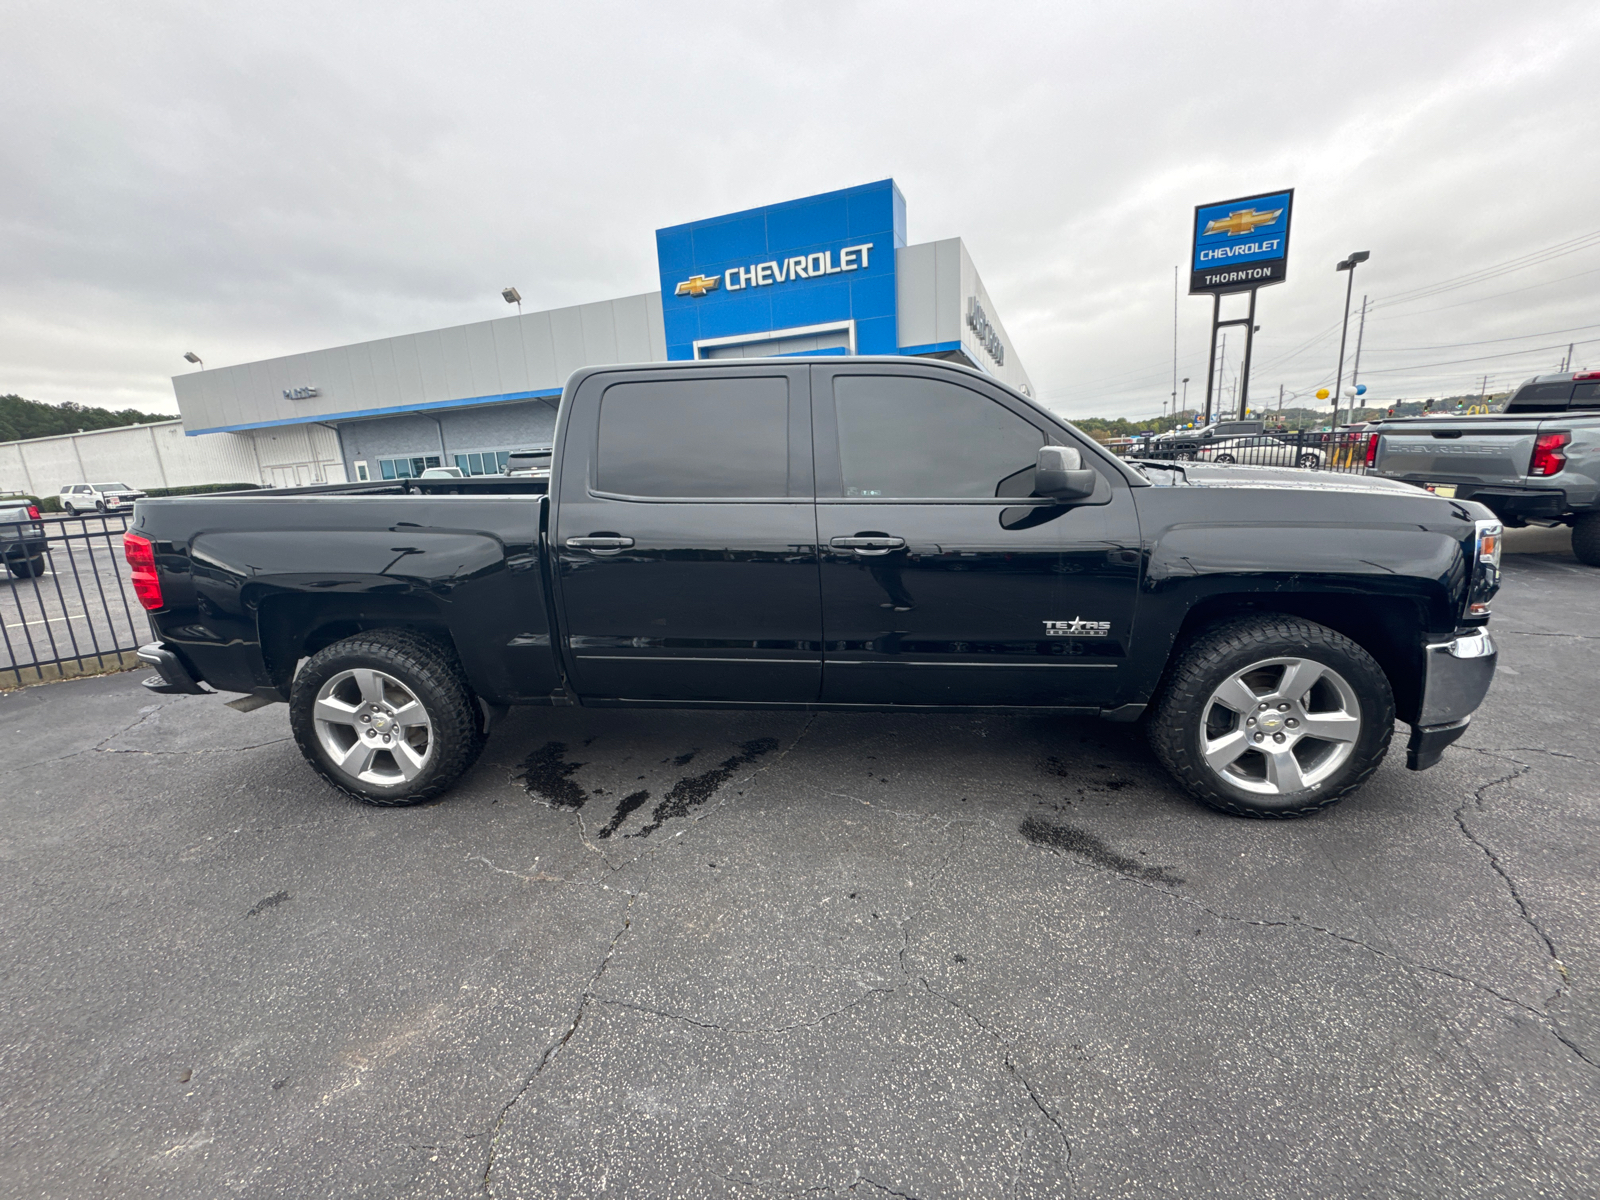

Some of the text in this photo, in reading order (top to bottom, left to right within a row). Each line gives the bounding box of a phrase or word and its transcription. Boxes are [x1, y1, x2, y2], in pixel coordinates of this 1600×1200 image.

[1200, 239, 1280, 261] CHEVROLET
[724, 242, 874, 291] CHEVROLET
[1205, 267, 1271, 284] THORNTON
[1386, 444, 1510, 455] CHEVROLET
